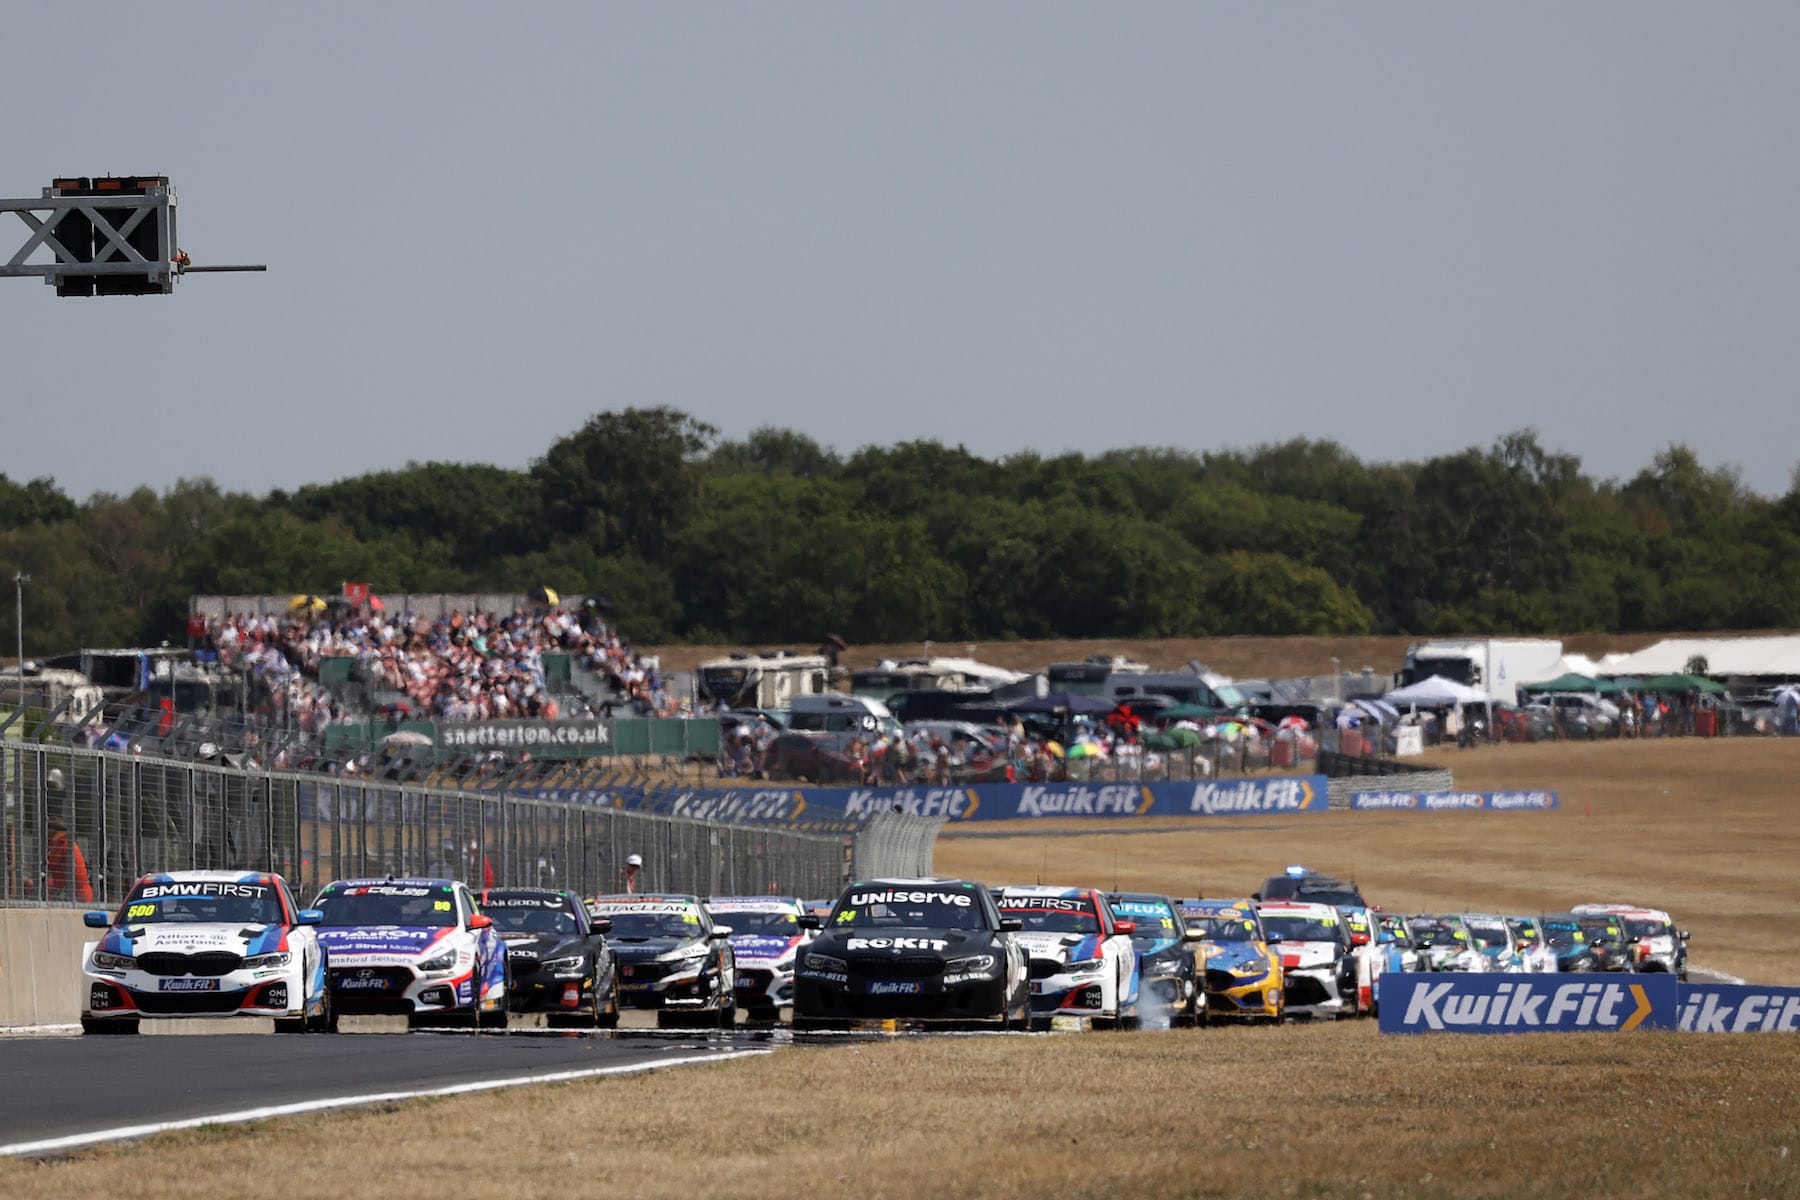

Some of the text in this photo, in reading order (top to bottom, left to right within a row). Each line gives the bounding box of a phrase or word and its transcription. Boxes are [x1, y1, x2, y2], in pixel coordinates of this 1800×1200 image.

[444, 724, 609, 745] snetterton.co.uk
[127, 905, 156, 917] 500
[590, 904, 688, 912] ATACLEAN
[329, 955, 367, 963] ansford
[269, 989, 287, 997] ONE
[1677, 993, 1800, 1033] ikFit
